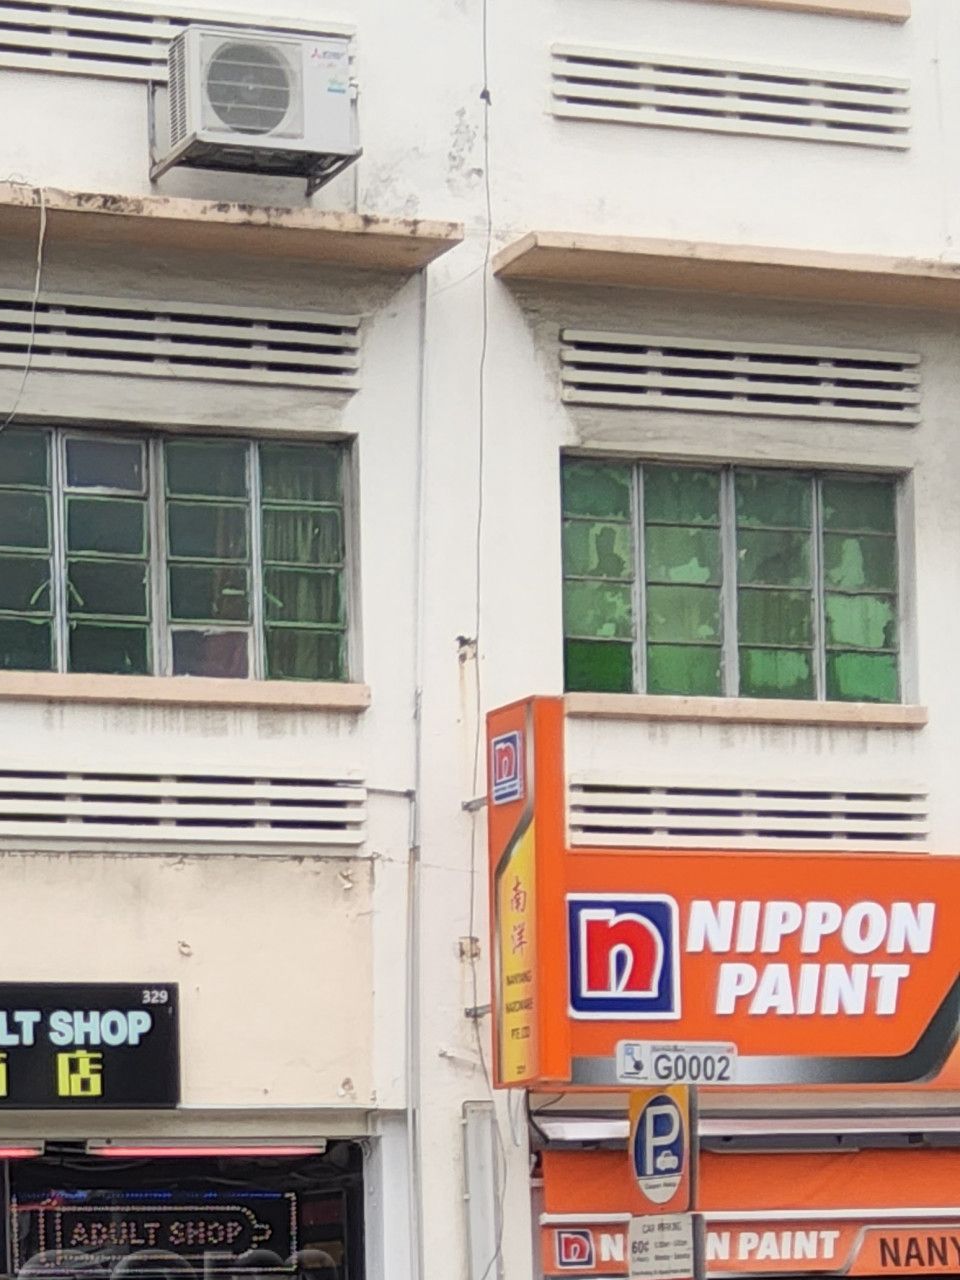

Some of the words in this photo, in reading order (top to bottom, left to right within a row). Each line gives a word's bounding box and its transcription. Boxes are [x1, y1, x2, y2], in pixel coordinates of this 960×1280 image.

[686, 900, 936, 954] NIPPON
[142, 990, 169, 1004] 329
[716, 963, 910, 1015] PAINT
[49, 1010, 152, 1046] SHOP
[654, 1054, 730, 1081] G0002
[70, 1221, 161, 1246] ADULT
[169, 1221, 243, 1246] SHOP
[738, 1230, 840, 1261] PAINT
